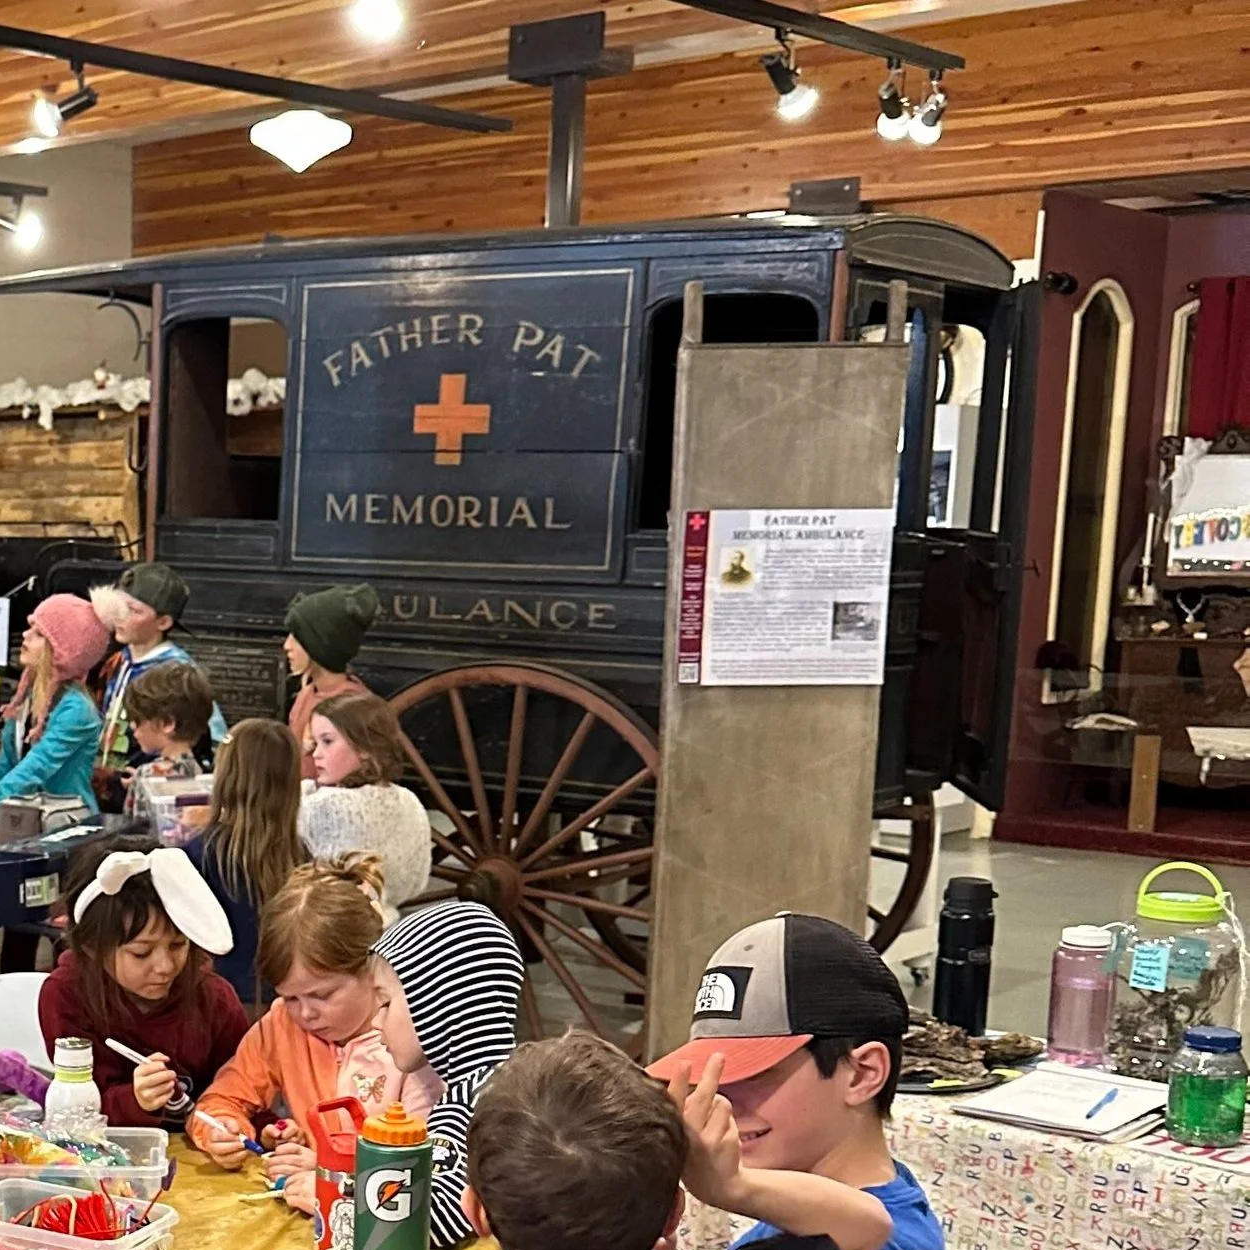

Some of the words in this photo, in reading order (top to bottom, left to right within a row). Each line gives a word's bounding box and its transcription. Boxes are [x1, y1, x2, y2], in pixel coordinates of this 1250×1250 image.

[322, 313, 485, 388] FATHER
[511, 320, 602, 379] PAT
[325, 493, 574, 530] MEMORIAL
[764, 515, 810, 526] FATHER
[812, 515, 837, 526] PAT
[733, 530, 792, 541] MEMORIAL
[796, 529, 866, 541] AMBULANCE
[377, 594, 618, 631] ULANCE
[365, 1168, 412, 1222] G
